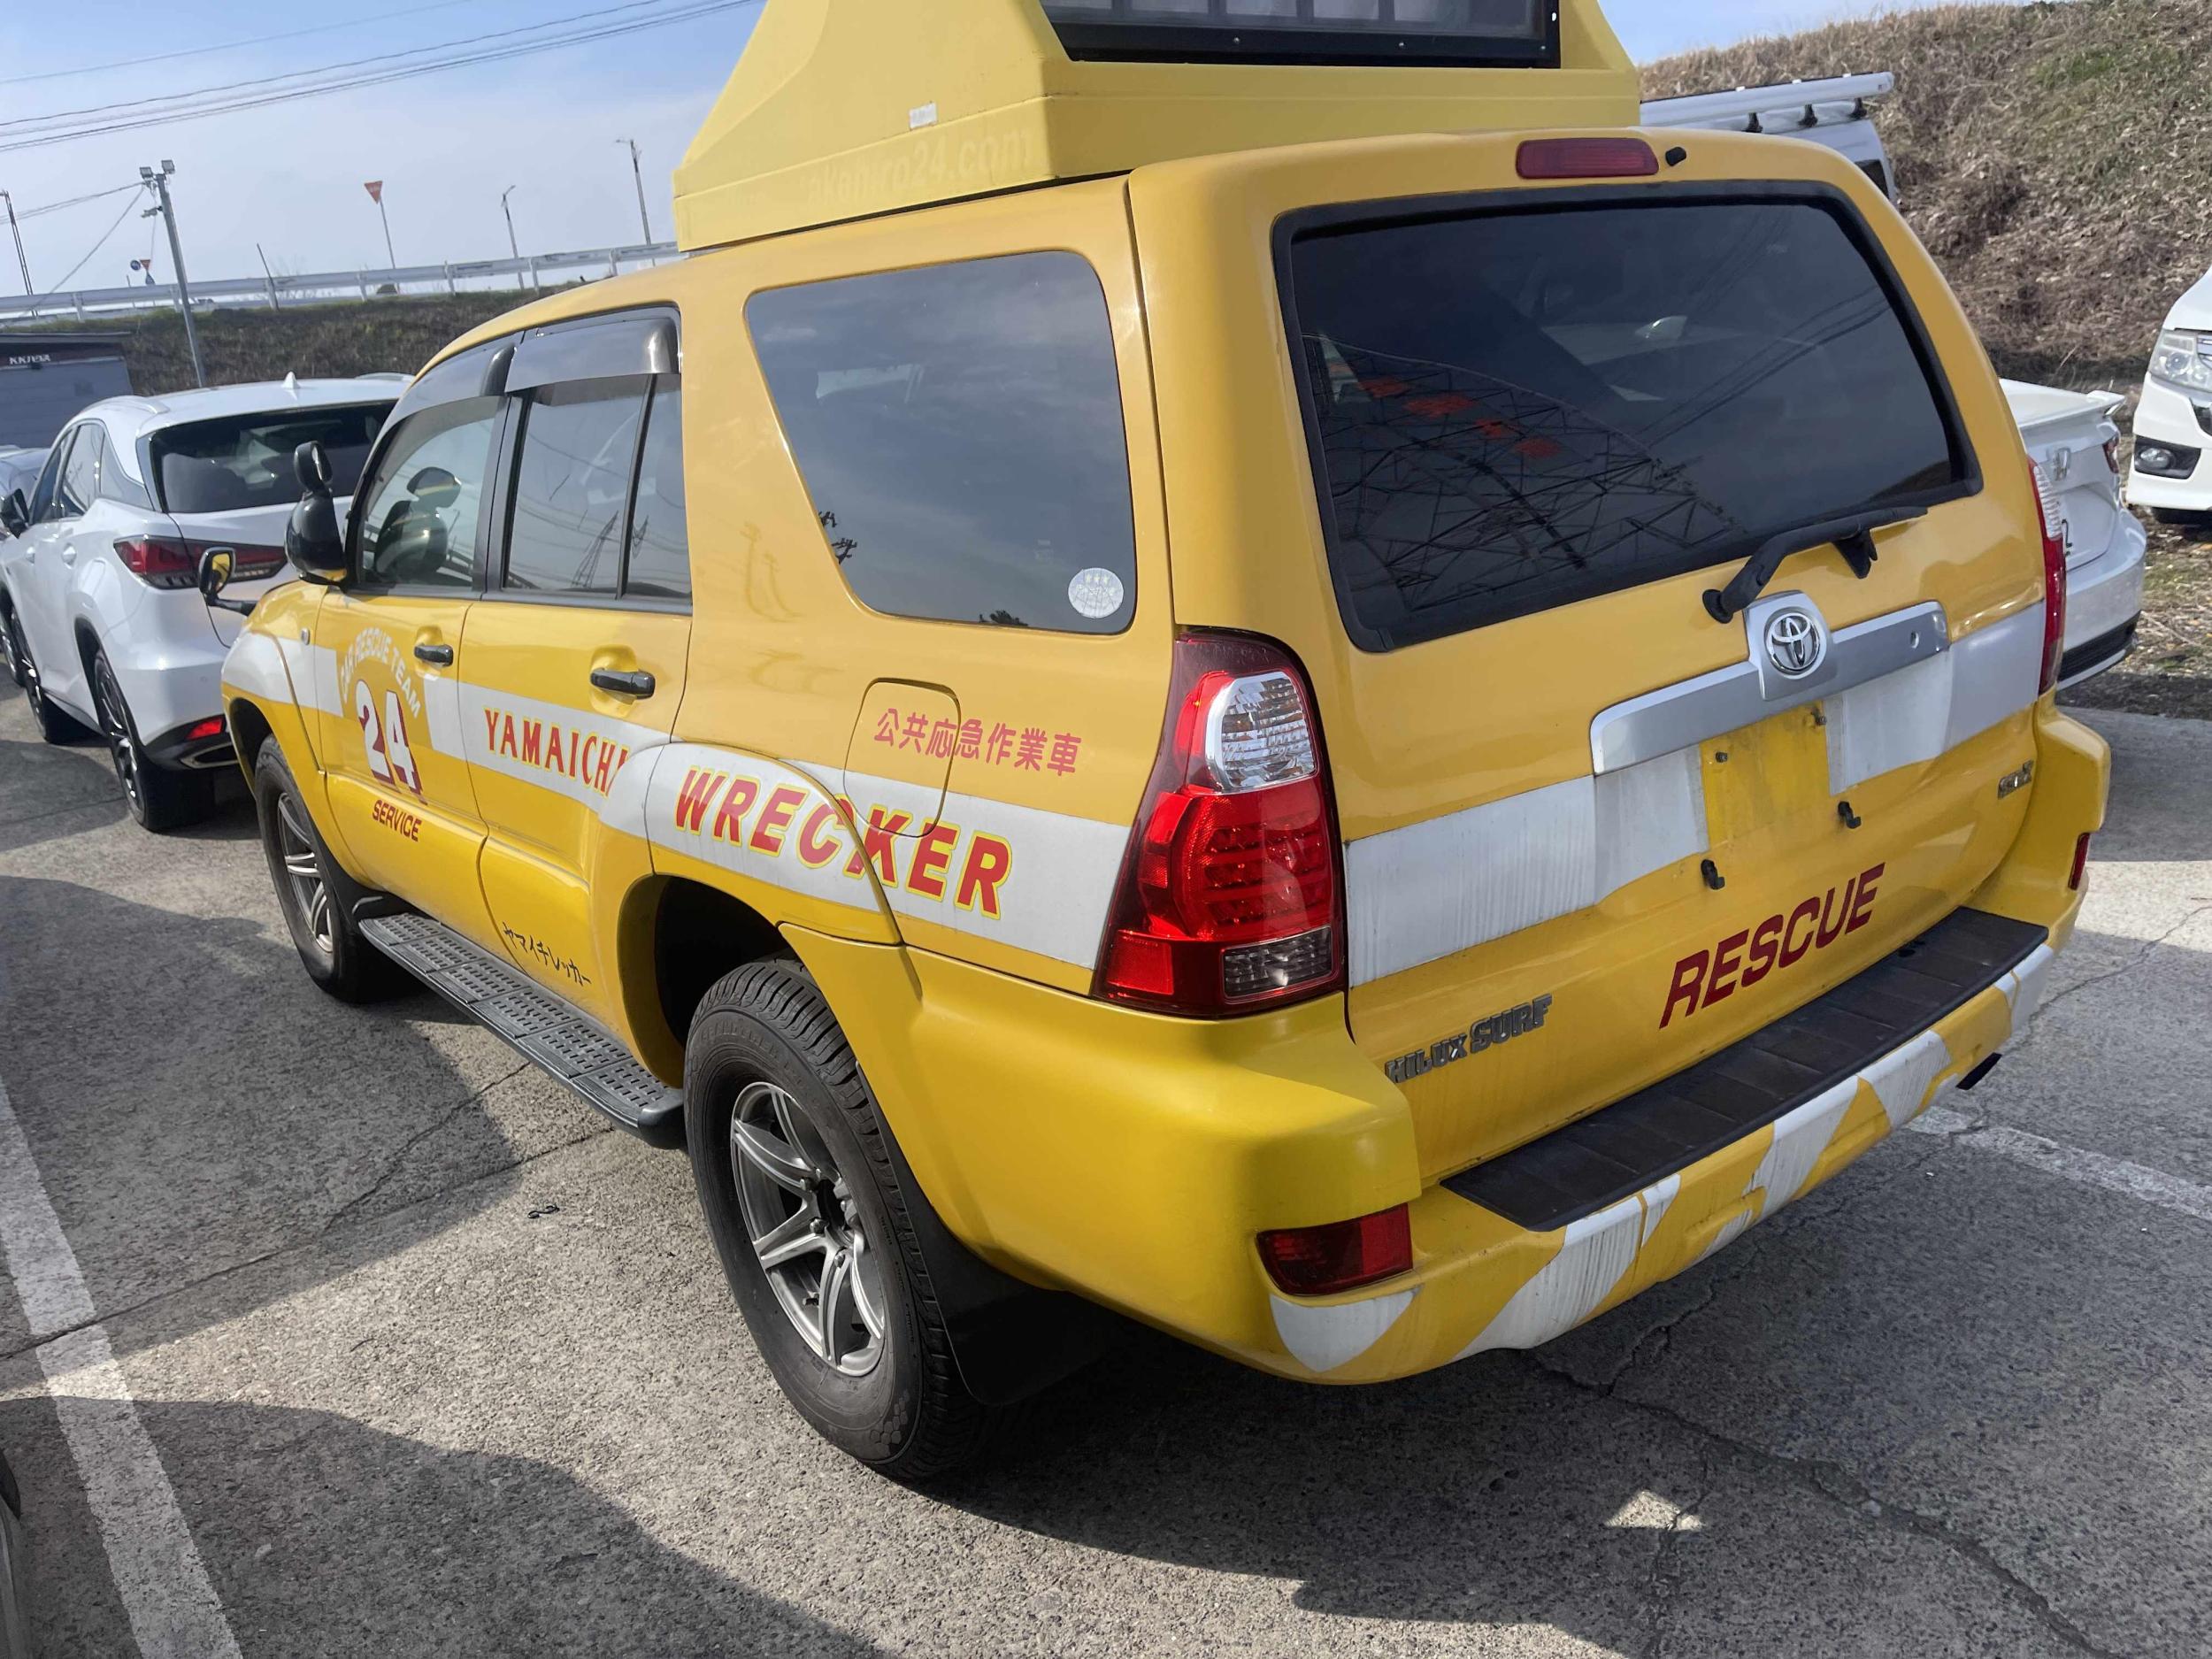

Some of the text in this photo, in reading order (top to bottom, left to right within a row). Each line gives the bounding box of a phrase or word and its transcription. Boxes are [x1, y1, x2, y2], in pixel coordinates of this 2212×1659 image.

[354, 627, 392, 667] RESCUE
[390, 647, 421, 719] TEAM
[356, 679, 428, 806] 24
[873, 708, 1083, 777] 公共応急作業車
[372, 799, 423, 842] SERVICE
[674, 764, 1013, 921] WRECKER
[1657, 861, 1886, 1031] RESCUE
[1384, 992, 1553, 1093] HILUX SURF
